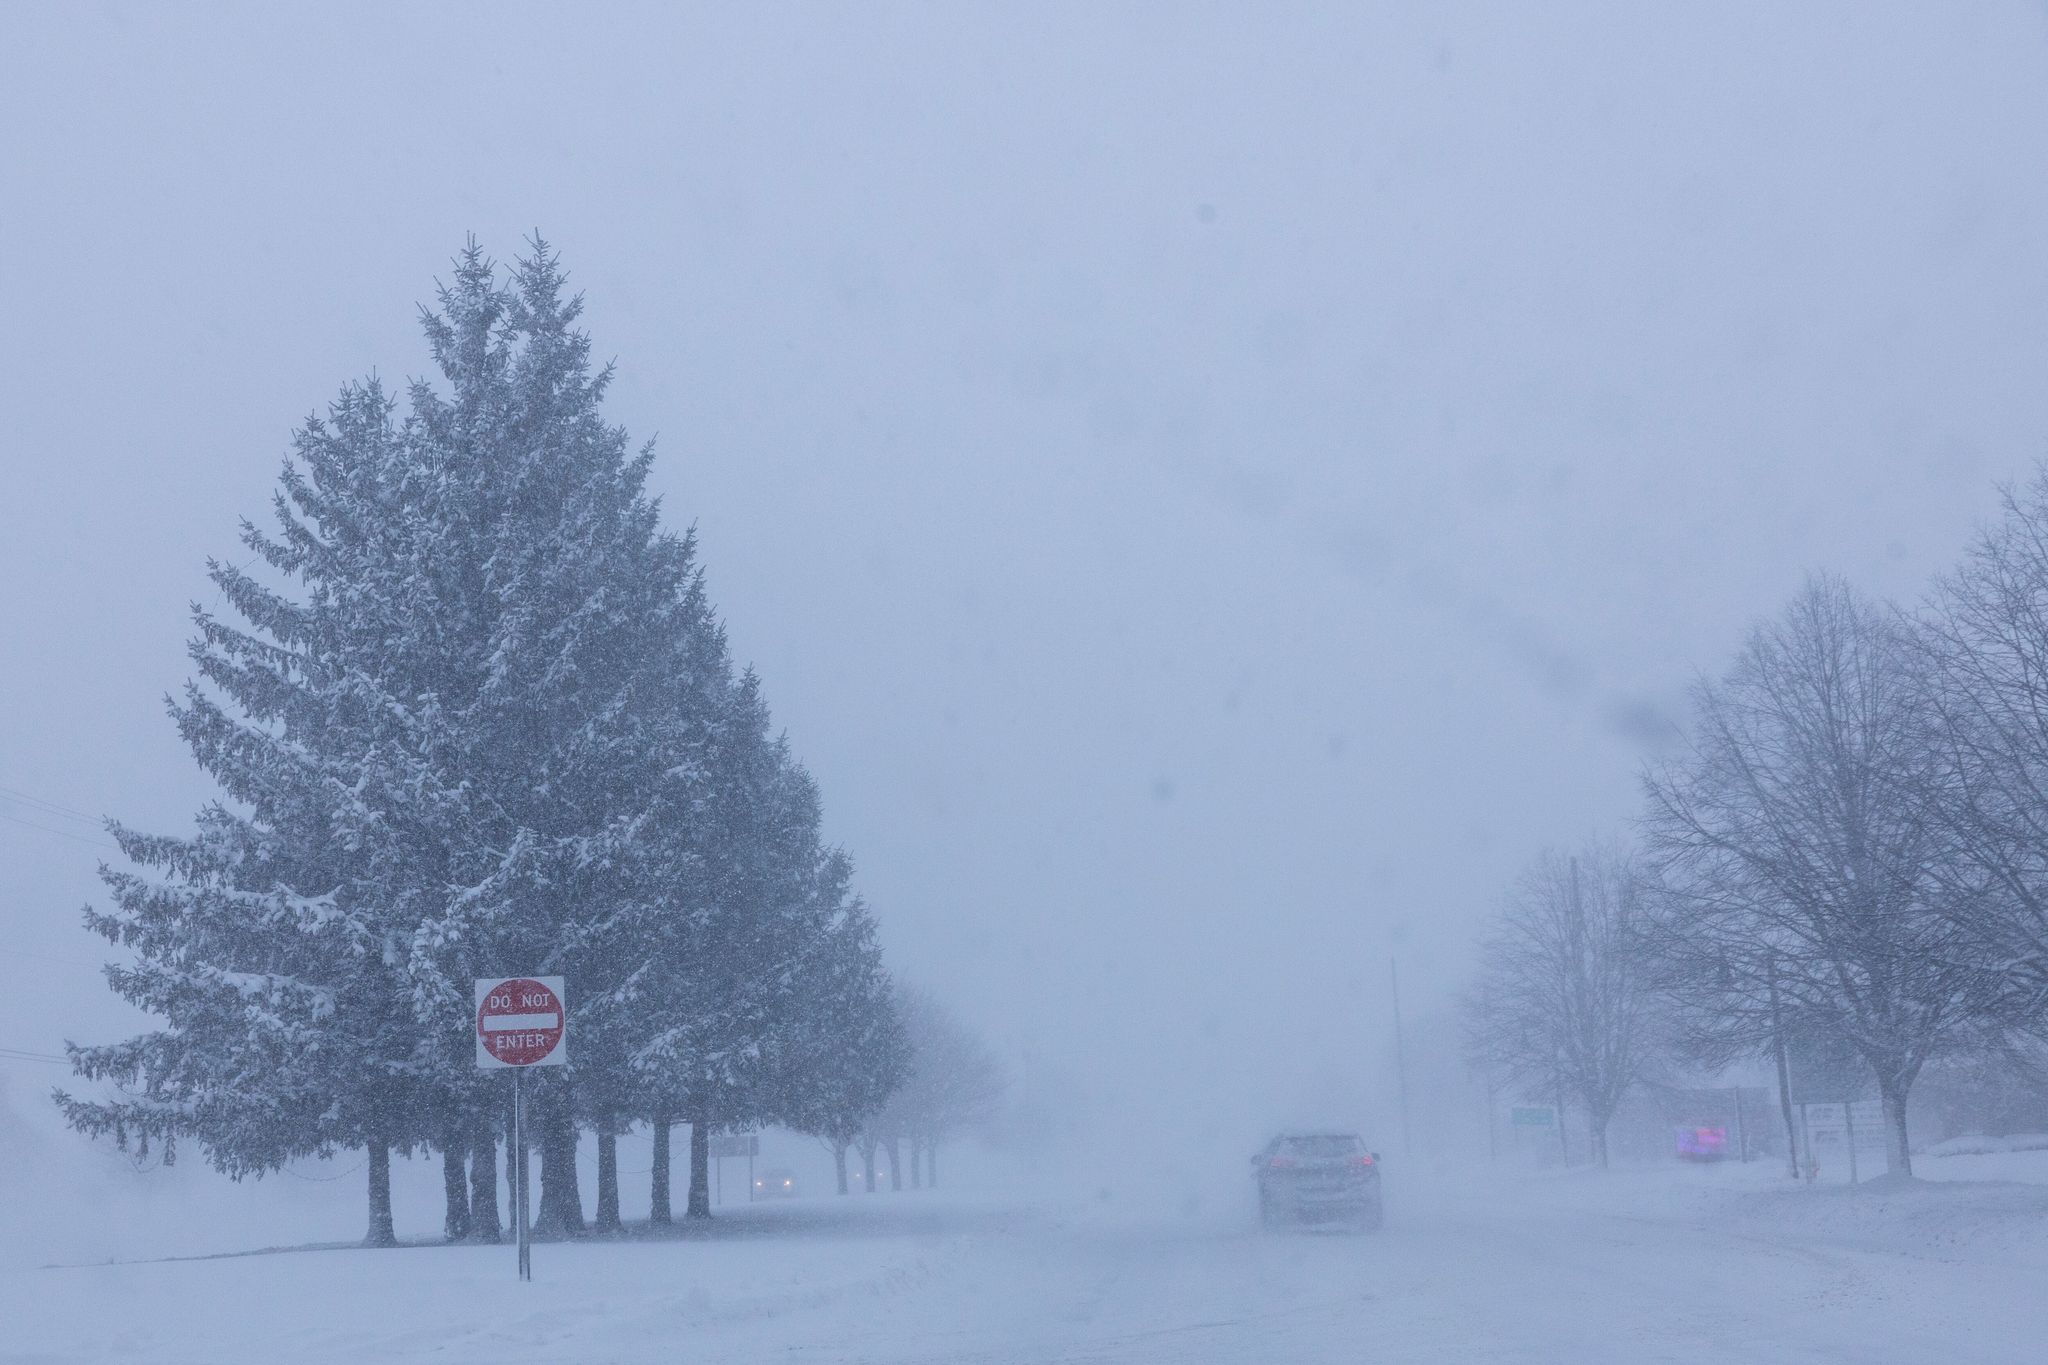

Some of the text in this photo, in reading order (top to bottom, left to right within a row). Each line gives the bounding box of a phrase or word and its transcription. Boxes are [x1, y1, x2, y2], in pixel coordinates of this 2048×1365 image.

[490, 993, 550, 1009] DO NOT
[496, 1033, 545, 1049] ENTER
